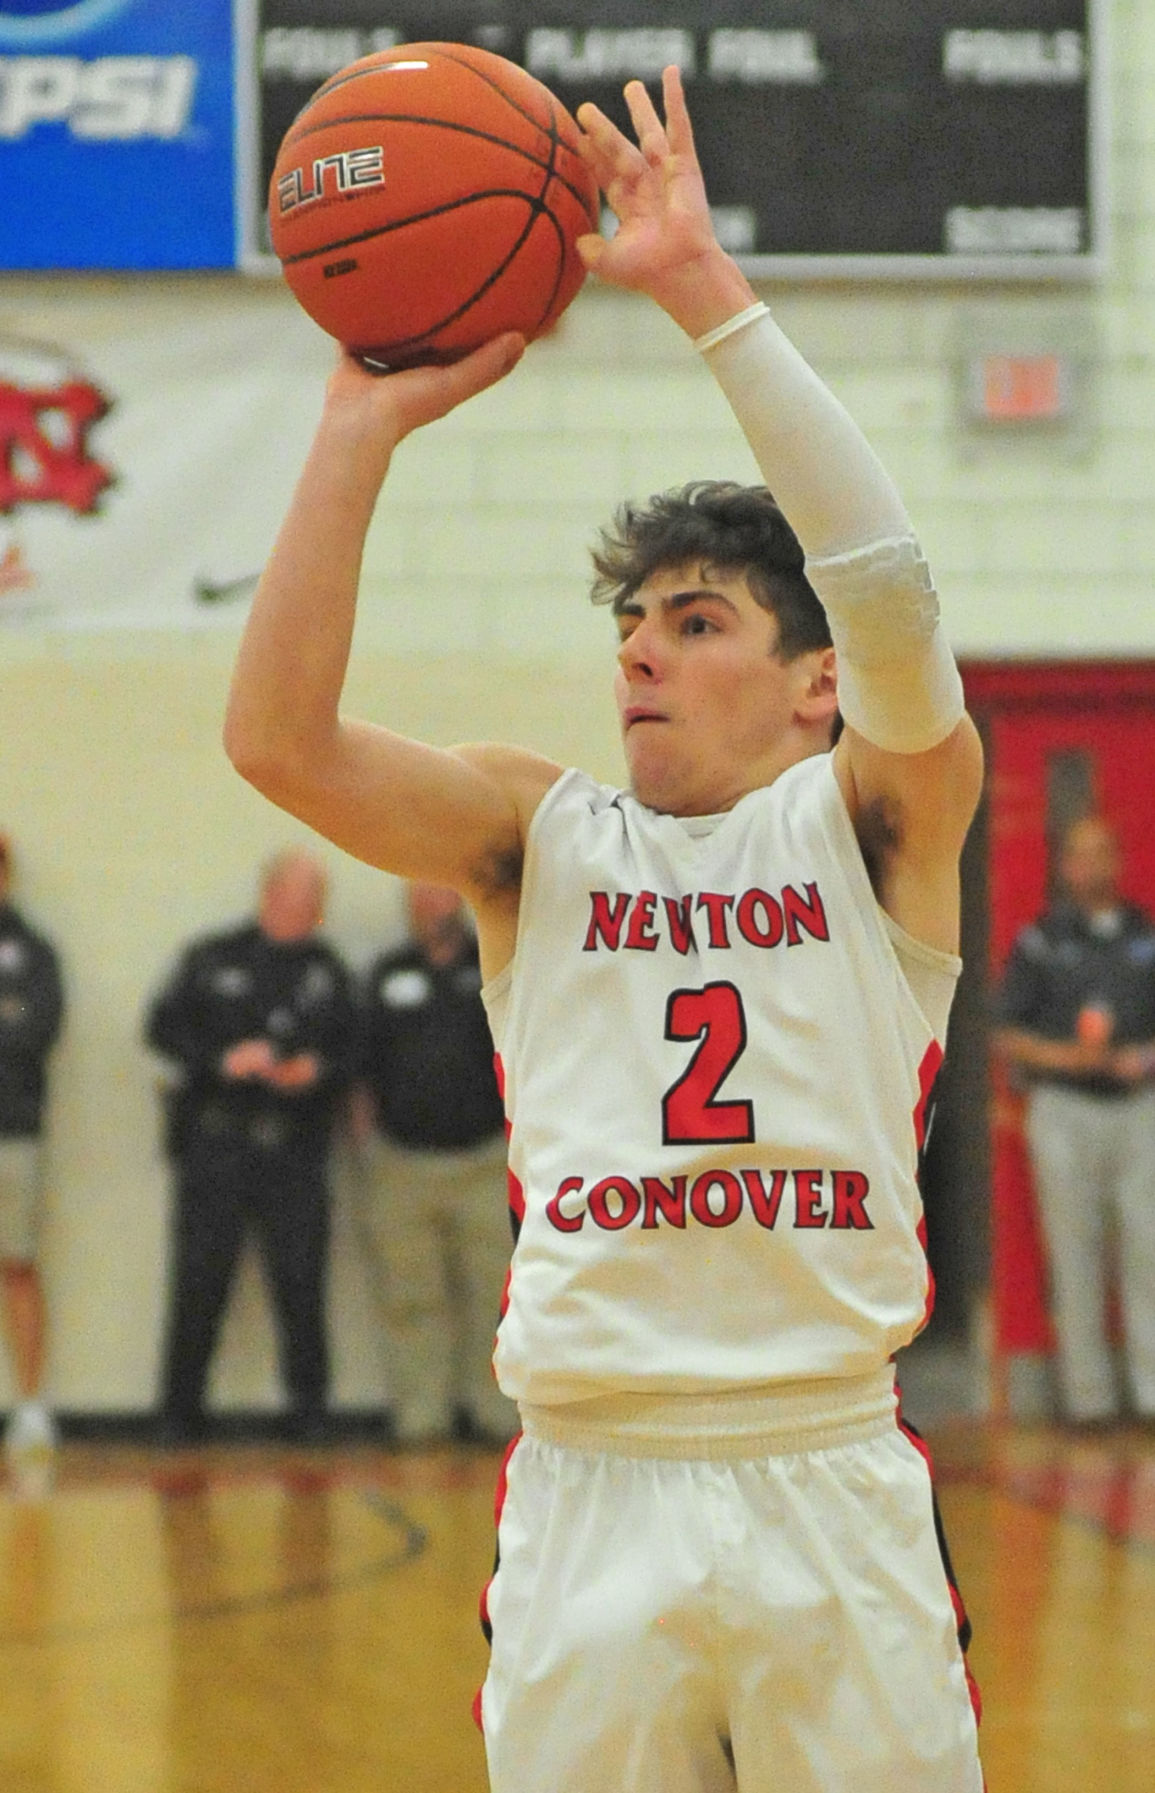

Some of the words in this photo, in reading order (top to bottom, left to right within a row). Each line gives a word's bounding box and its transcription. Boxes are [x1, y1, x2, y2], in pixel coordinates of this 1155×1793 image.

[278, 145, 386, 217] ELITE
[582, 881, 831, 955] NEWTON
[661, 980, 756, 1146] 2
[545, 1168, 875, 1233] CONOVER
